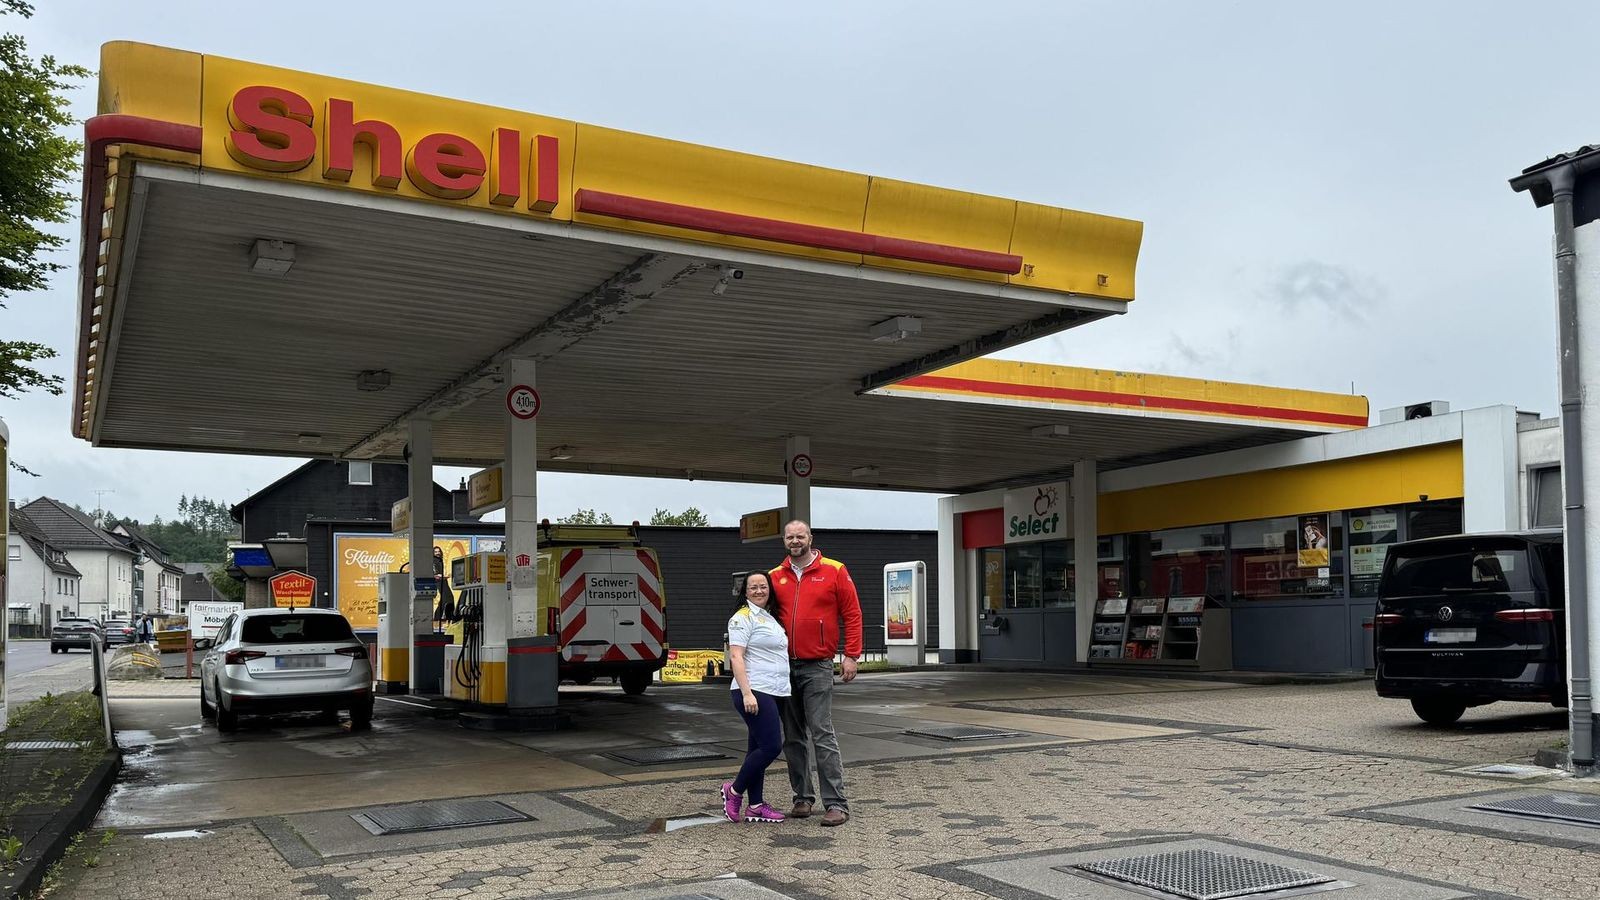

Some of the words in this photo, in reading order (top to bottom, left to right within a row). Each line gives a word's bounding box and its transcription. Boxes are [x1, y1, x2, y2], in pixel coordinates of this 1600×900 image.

[226, 85, 559, 212] Shell
[1009, 513, 1059, 537] Select
[344, 548, 396, 569] Kaulitz
[279, 578, 310, 590] Textil-
[591, 577, 633, 587] Schwer-
[589, 590, 636, 600] transport
[194, 604, 232, 613] fairmarkt
